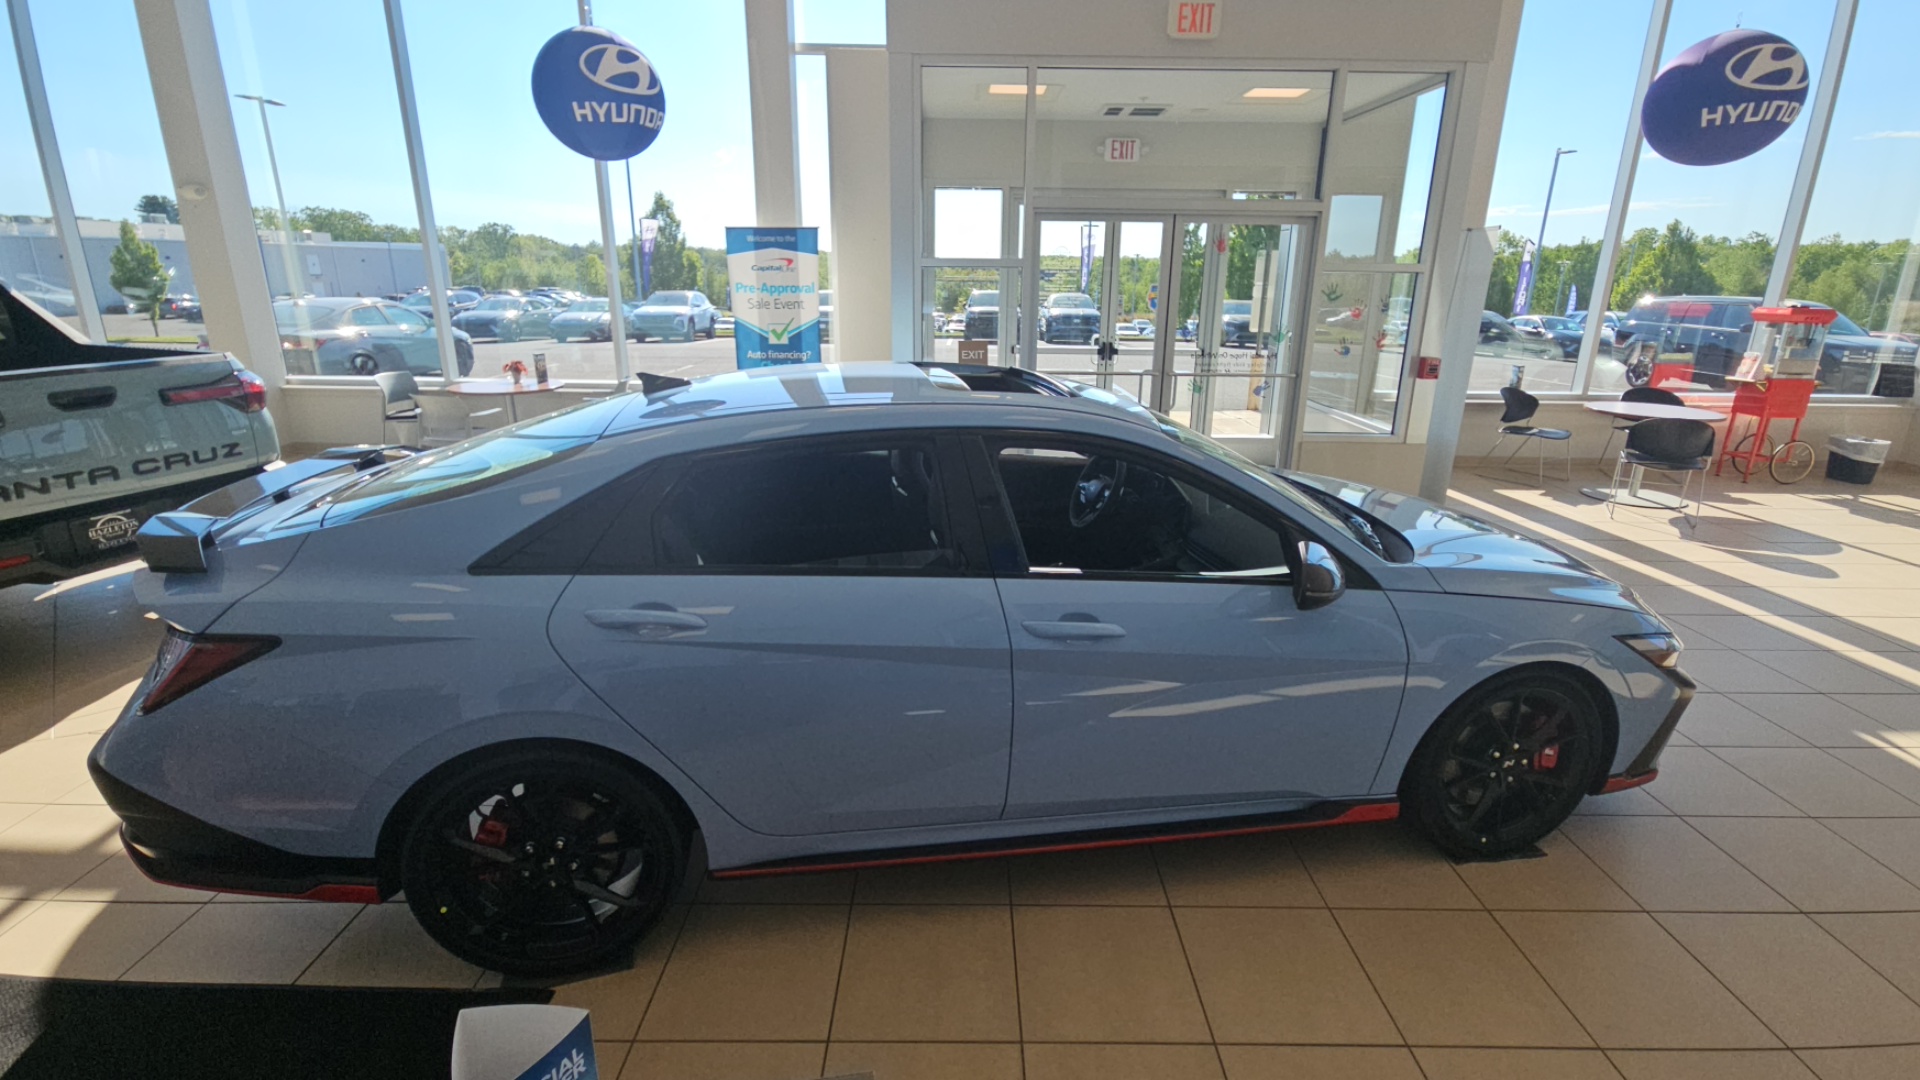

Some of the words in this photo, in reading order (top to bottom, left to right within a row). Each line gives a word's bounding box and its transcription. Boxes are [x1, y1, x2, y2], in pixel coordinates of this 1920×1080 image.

[1177, 3, 1215, 33] EXIT
[1701, 100, 1803, 128] HYUND
[1111, 139, 1136, 160] EXIT
[735, 281, 815, 297] Pre-Approval
[748, 298, 771, 309] Sale
[774, 298, 806, 309] Event
[747, 350, 767, 359] Auto
[768, 350, 812, 361] financing?
[961, 350, 985, 359] EXIT
[132, 442, 244, 476] CRUZ
